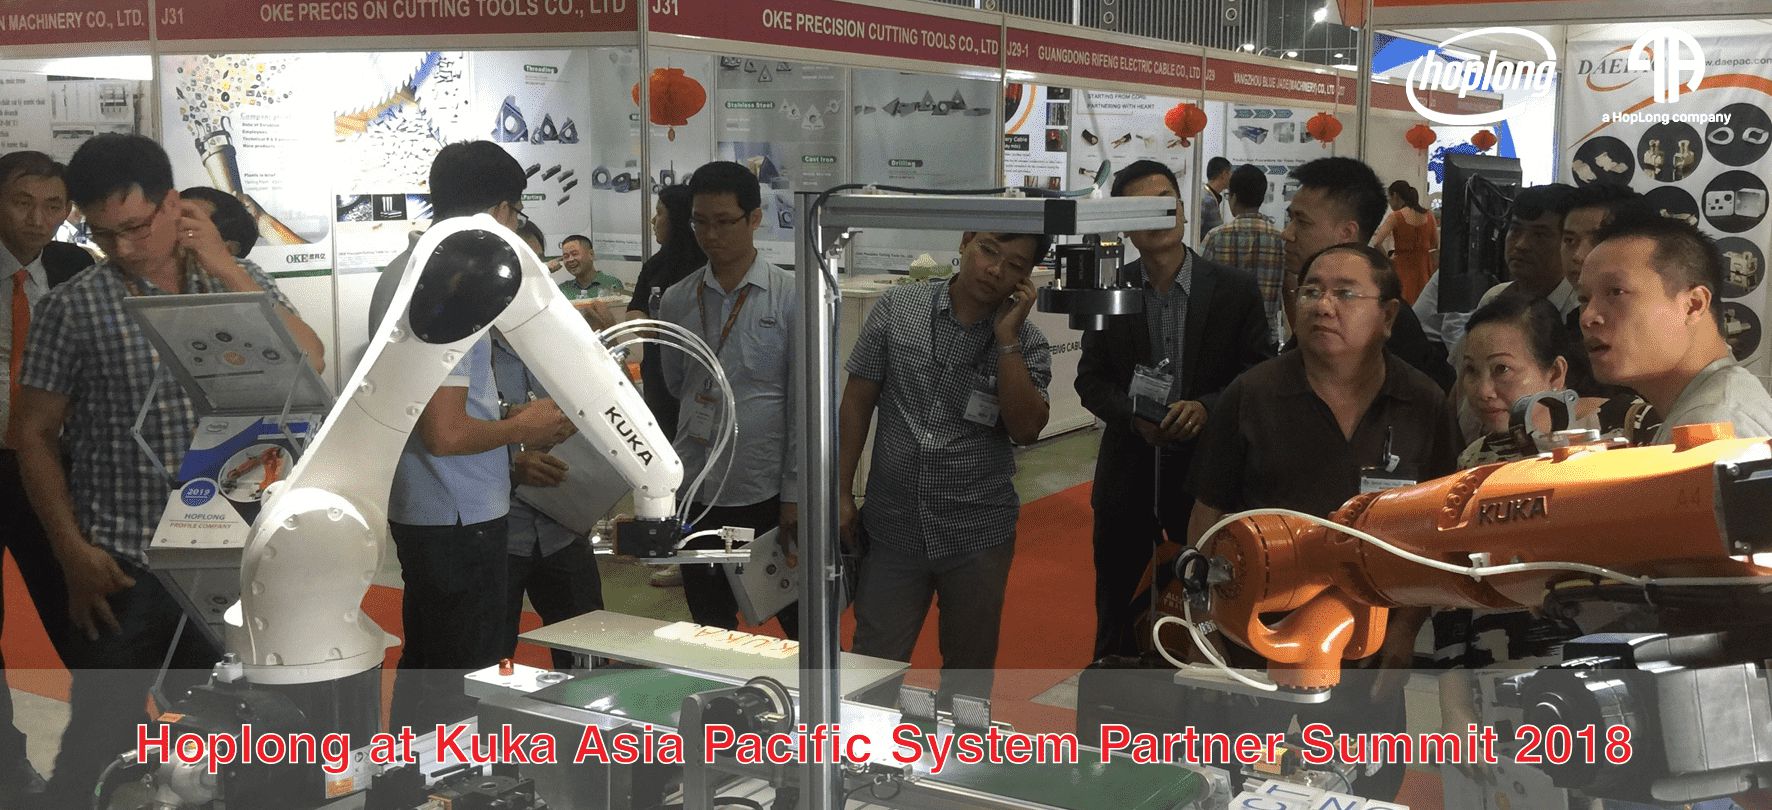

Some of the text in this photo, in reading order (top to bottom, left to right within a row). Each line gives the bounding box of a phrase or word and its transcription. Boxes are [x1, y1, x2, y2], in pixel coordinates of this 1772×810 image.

[161, 8, 184, 25] J31
[260, 4, 294, 22] OKE
[393, 0, 470, 18] CUTTING
[478, 0, 538, 16] TOOLS
[545, 0, 584, 17] CO.,
[590, 0, 625, 14] LTD
[653, 0, 679, 16] J31
[9, 13, 83, 31] MACHINERY
[86, 11, 113, 29] CO.,
[116, 10, 144, 27] LTD.
[762, 9, 999, 56] OKE PRECISION CUTTING TOOLS CO., LTD
[1007, 41, 1029, 58] J29-1
[1038, 45, 1200, 80] GUANGDONG RIFENG ELECTRIC CABLE CO., LTD
[727, 101, 773, 109] Stainless Steel
[286, 254, 308, 264] OKE
[605, 406, 653, 466] KUKA
[184, 513, 225, 521] HOPLONG
[1478, 496, 1548, 525] KUKA
